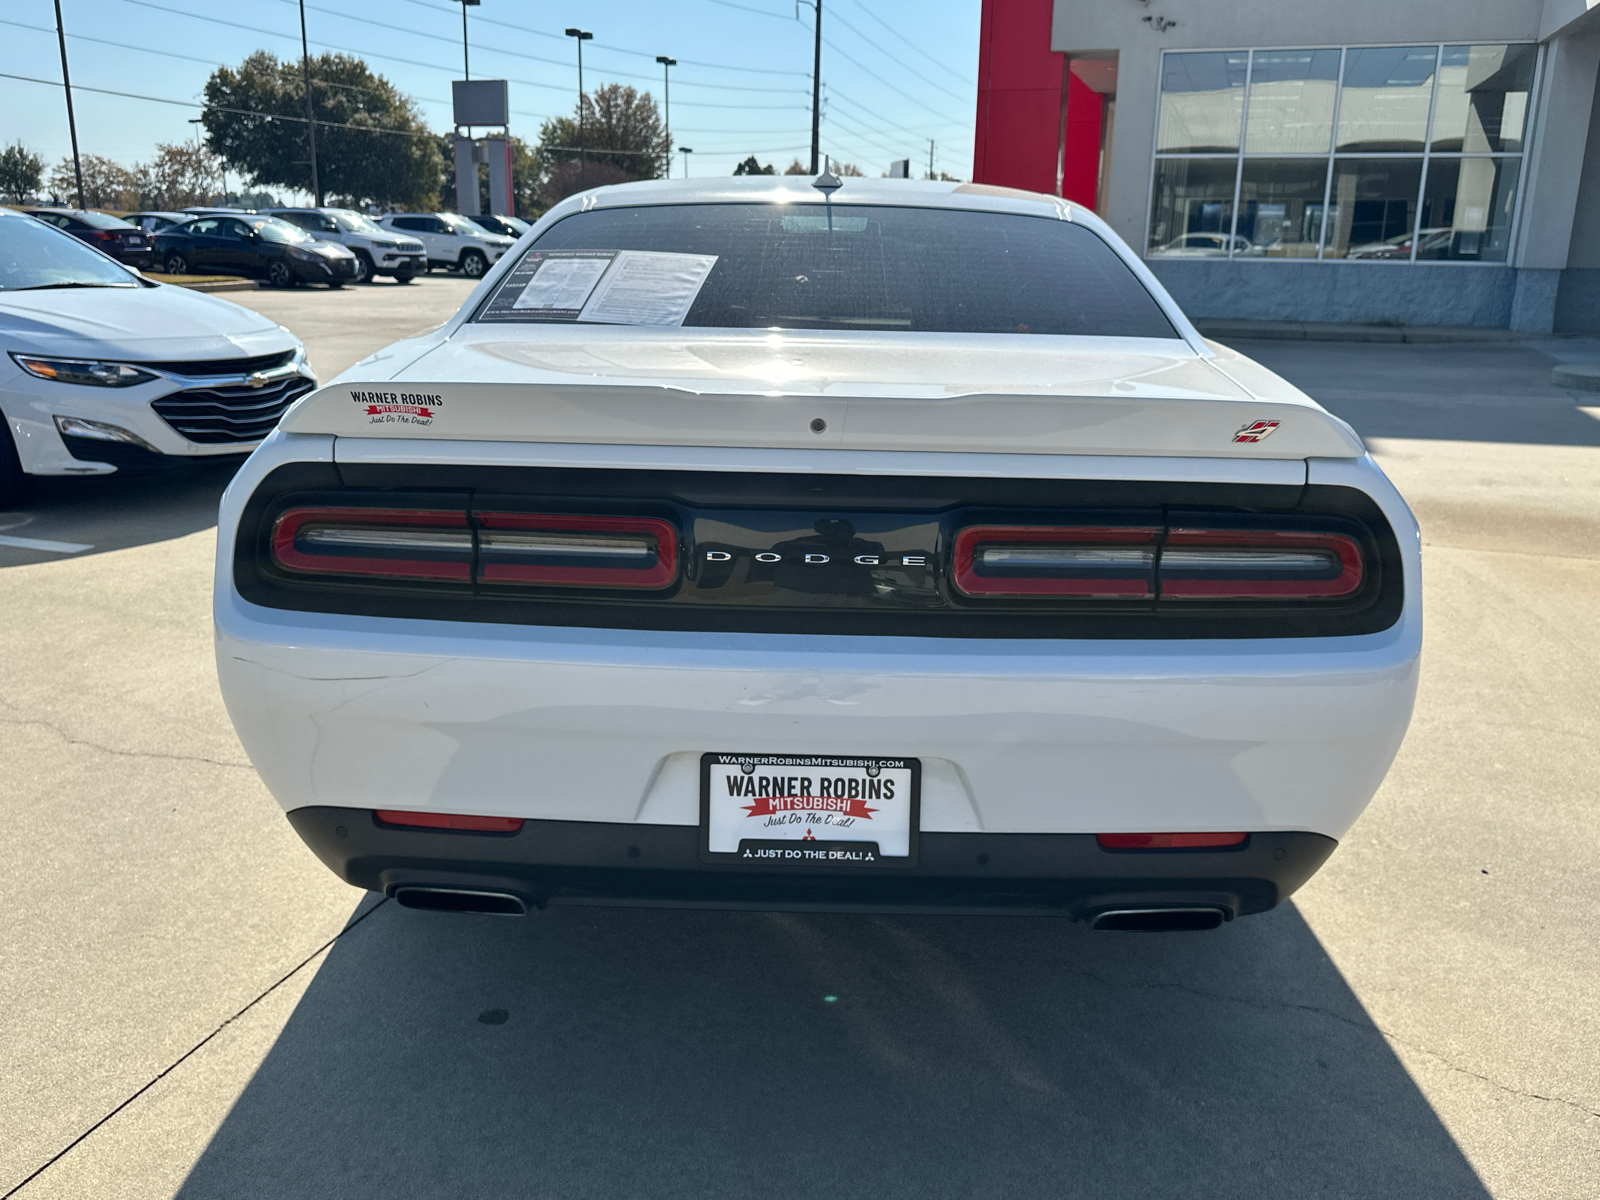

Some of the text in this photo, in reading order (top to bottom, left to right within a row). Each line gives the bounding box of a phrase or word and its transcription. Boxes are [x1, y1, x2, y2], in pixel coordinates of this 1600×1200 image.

[350, 391, 443, 406] WARNER ROBINS
[376, 405, 422, 414] MITSUBISHI
[370, 414, 433, 427] Just Do The Deal!
[706, 551, 926, 566] DODGE
[726, 775, 895, 800] WARNER ROBINS
[769, 796, 851, 812] MITSUBISHI
[764, 813, 855, 828] Just Do The Deal!
[754, 850, 862, 860] JUST DO THE DEAL!
